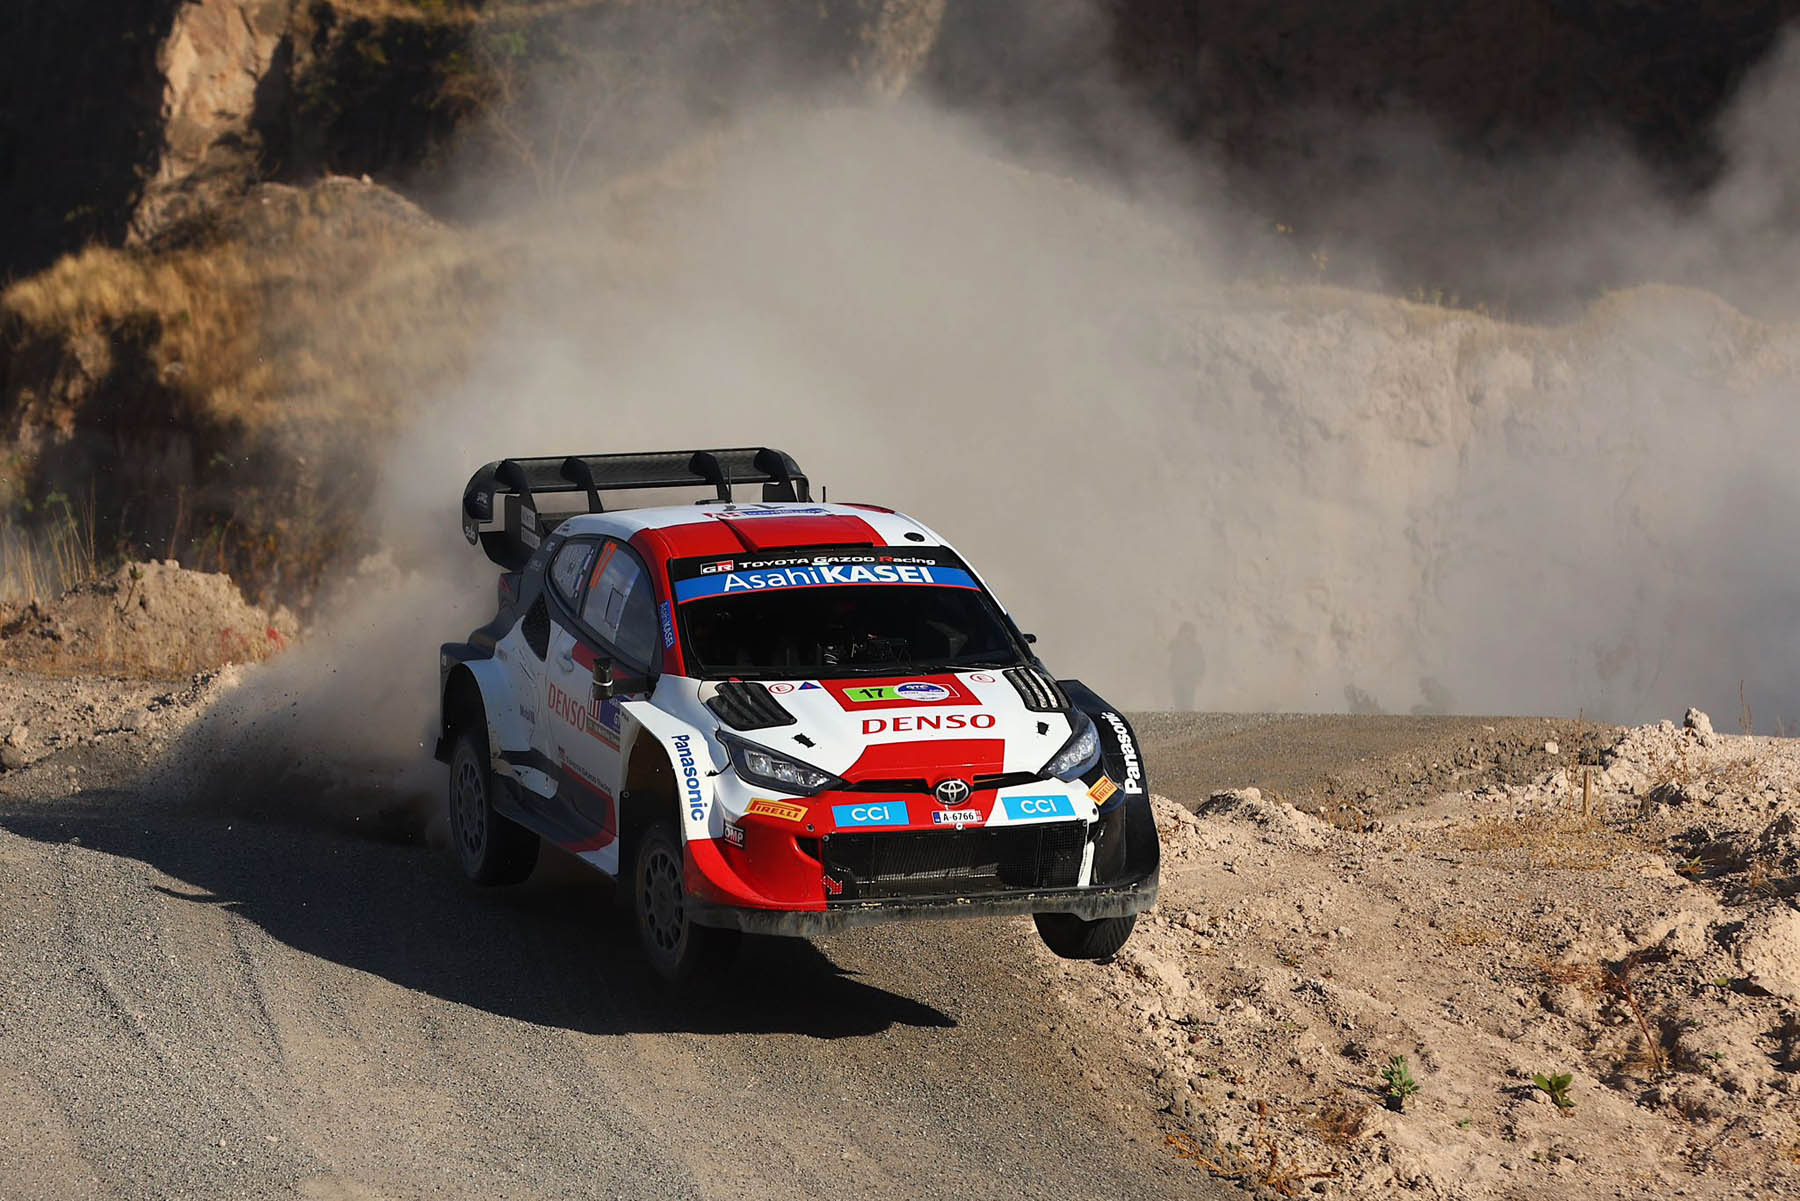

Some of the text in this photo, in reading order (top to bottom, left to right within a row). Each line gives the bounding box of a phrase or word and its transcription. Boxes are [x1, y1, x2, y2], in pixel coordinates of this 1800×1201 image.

[739, 558, 809, 568] TOYOTA
[811, 556, 875, 566] GAZOO
[880, 555, 936, 566] Racing
[859, 688, 884, 699] 17
[548, 683, 585, 732] DENSO
[862, 714, 996, 735] DENSO
[1101, 712, 1142, 794] Panasonic
[672, 735, 708, 821] Panasonic
[749, 800, 802, 818] PIRELLI
[851, 806, 890, 821] CCI
[1020, 798, 1057, 814] CCI
[943, 812, 974, 822] A-6766
[724, 827, 743, 842] OMP
